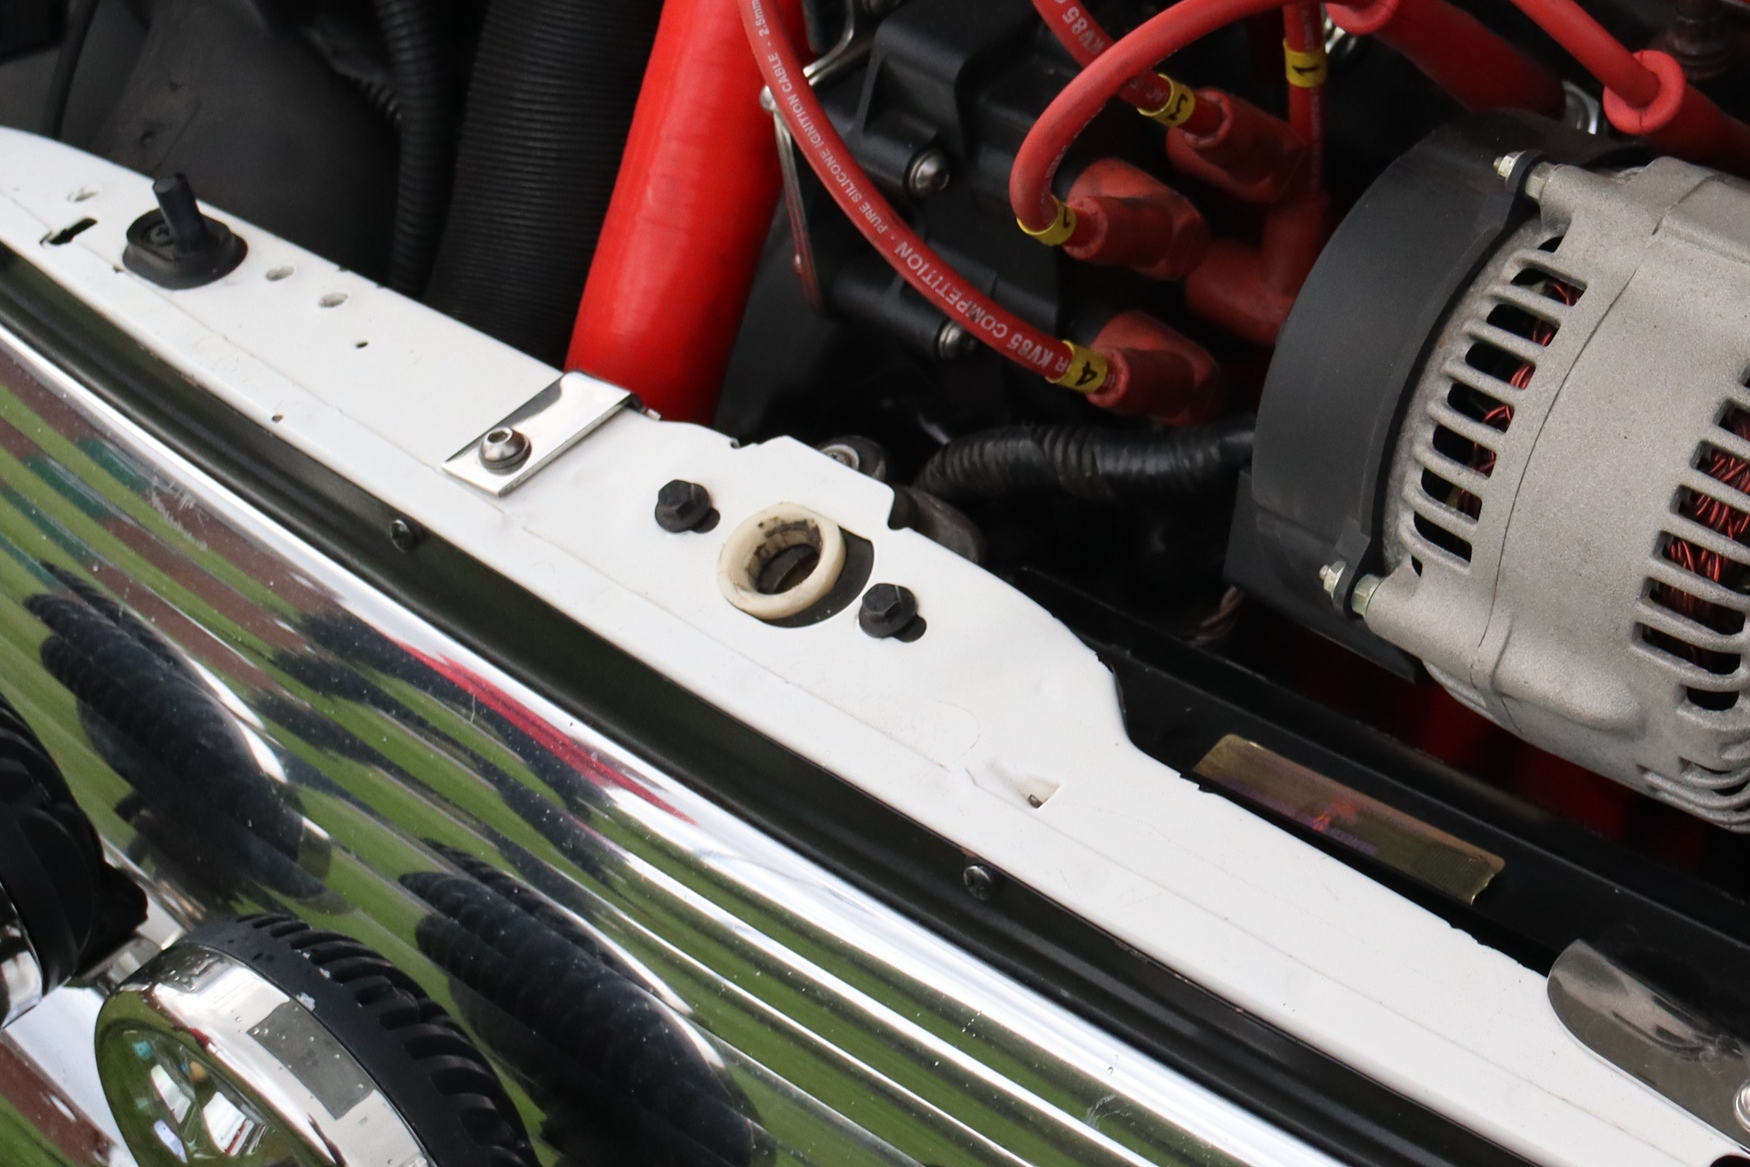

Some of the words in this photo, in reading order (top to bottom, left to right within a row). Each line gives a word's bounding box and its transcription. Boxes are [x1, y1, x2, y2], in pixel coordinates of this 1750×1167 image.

[767, 51, 793, 93] CABLE
[787, 93, 826, 149] IGNITION
[818, 149, 863, 202] SILICONE
[858, 202, 888, 235] PURE
[893, 240, 1009, 339] COMPETITION
[1007, 334, 1055, 368] KV85
[1075, 361, 1098, 387] 4
